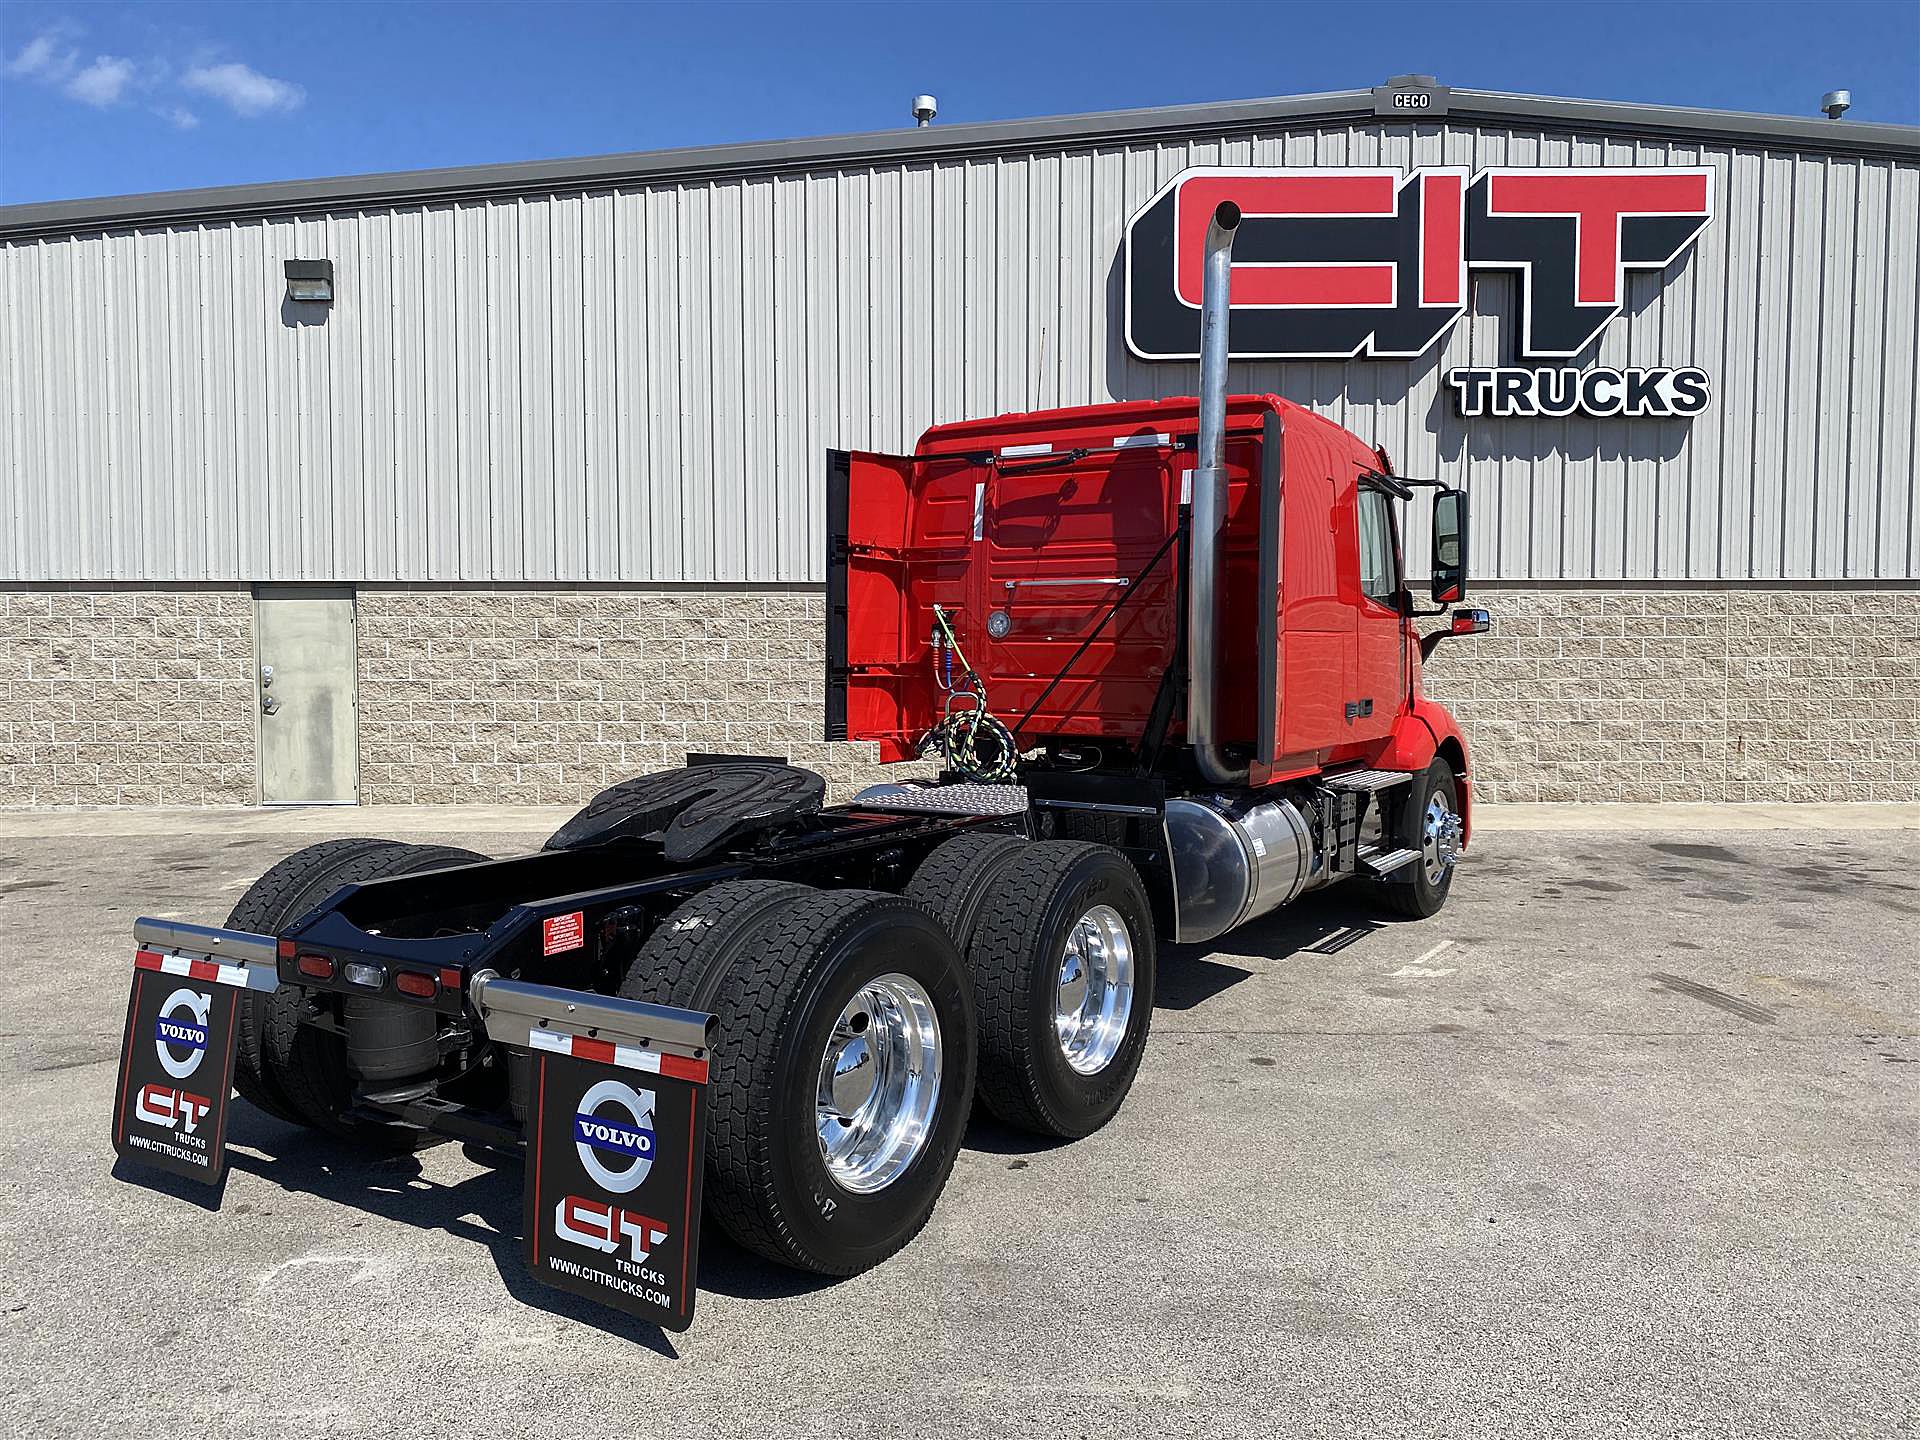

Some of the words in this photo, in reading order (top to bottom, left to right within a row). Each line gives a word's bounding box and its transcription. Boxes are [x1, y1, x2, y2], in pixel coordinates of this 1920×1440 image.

[1395, 94, 1428, 107] CECO
[1126, 167, 1715, 357] CIT
[1452, 369, 1710, 416] TRUCKS
[159, 1022, 205, 1044] VOLVO
[135, 1083, 211, 1133] CIT
[129, 1134, 209, 1167] WWW.CITTRUCKS.COM
[174, 1131, 206, 1149] TRUCKS
[579, 1120, 651, 1152] VOLVO
[555, 1195, 668, 1263] CIT
[549, 1256, 671, 1309] WWW.CITTRUCKS.COM
[616, 1259, 665, 1286] TRUCKS
